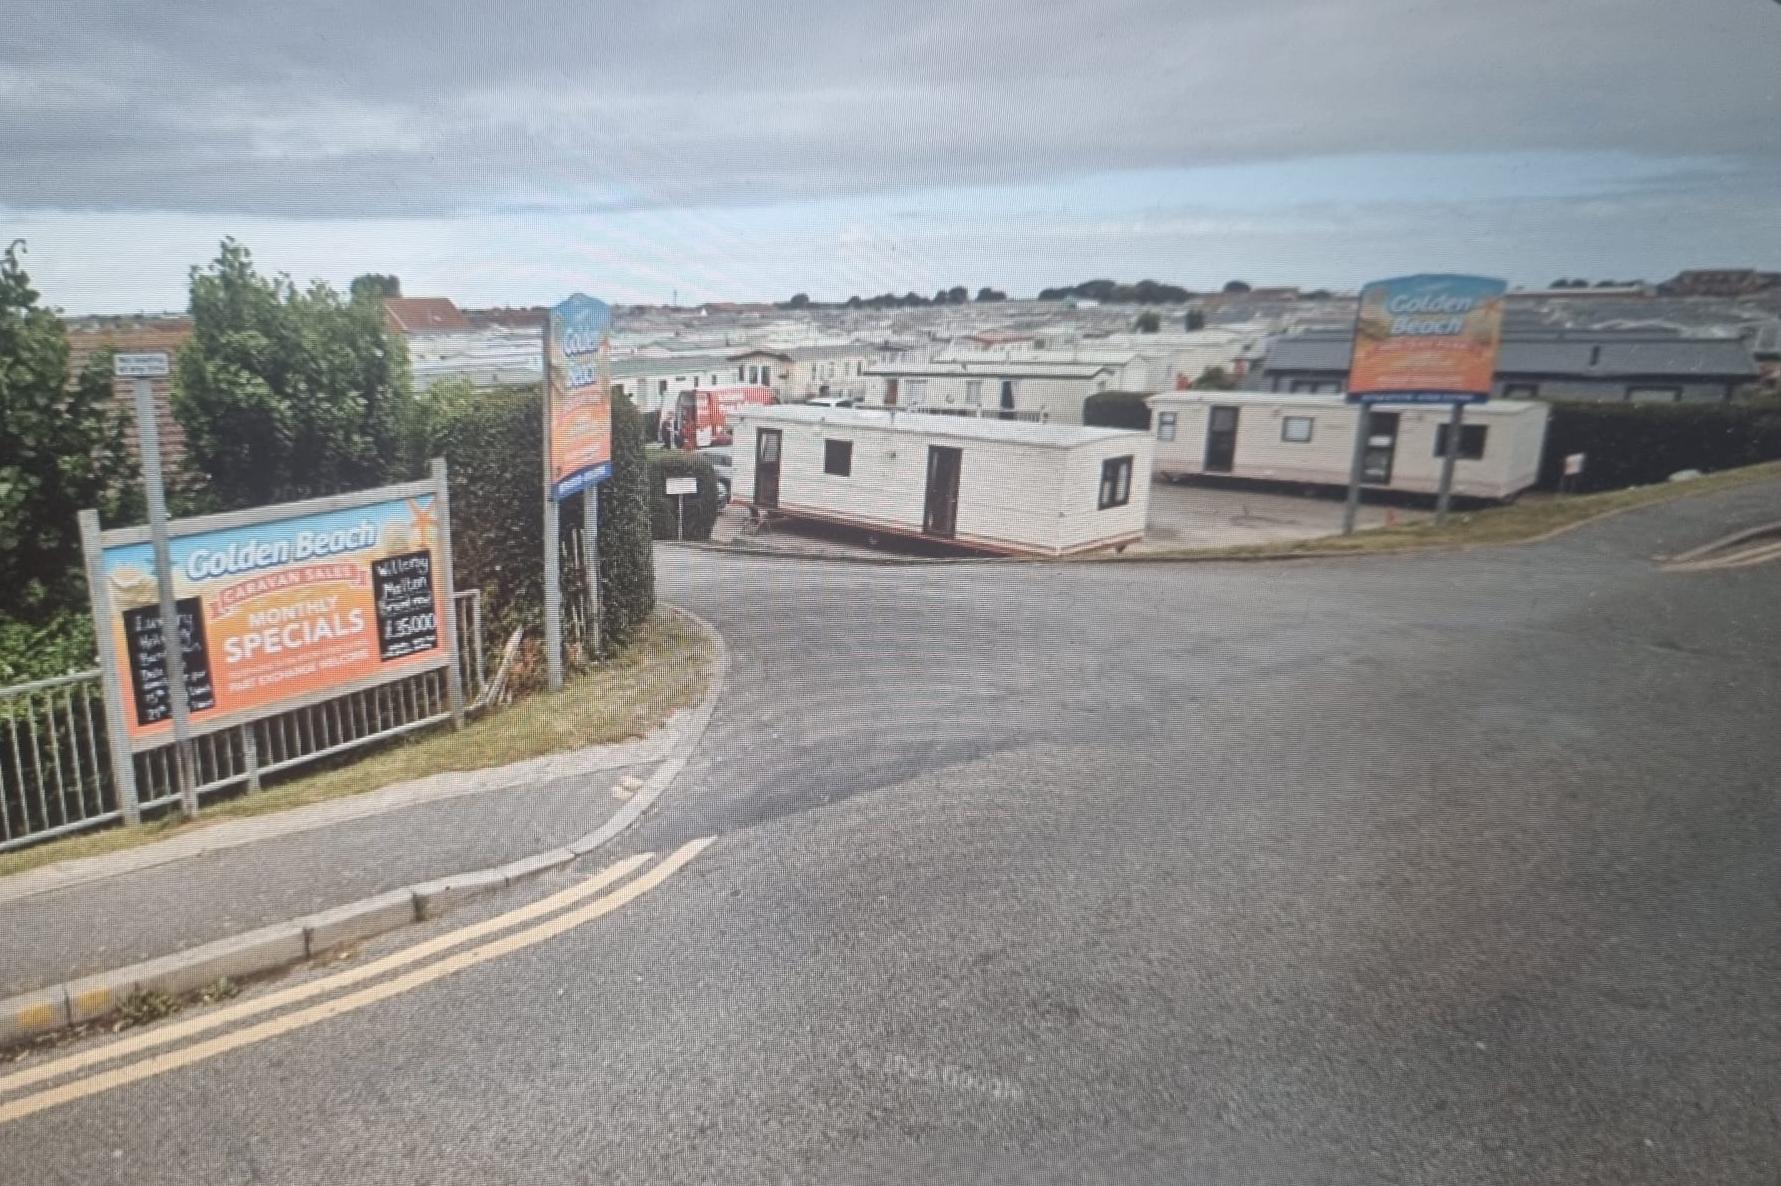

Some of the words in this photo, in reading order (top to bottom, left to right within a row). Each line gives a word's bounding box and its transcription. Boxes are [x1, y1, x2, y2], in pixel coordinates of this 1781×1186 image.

[1389, 294, 1473, 314] Golden
[1390, 314, 1464, 336] Beach
[186, 540, 290, 581] Golden
[294, 520, 379, 561] Beach
[223, 570, 301, 603] CARAVAN
[249, 596, 339, 628] MONTHLY
[223, 608, 365, 664] SPECIALS
